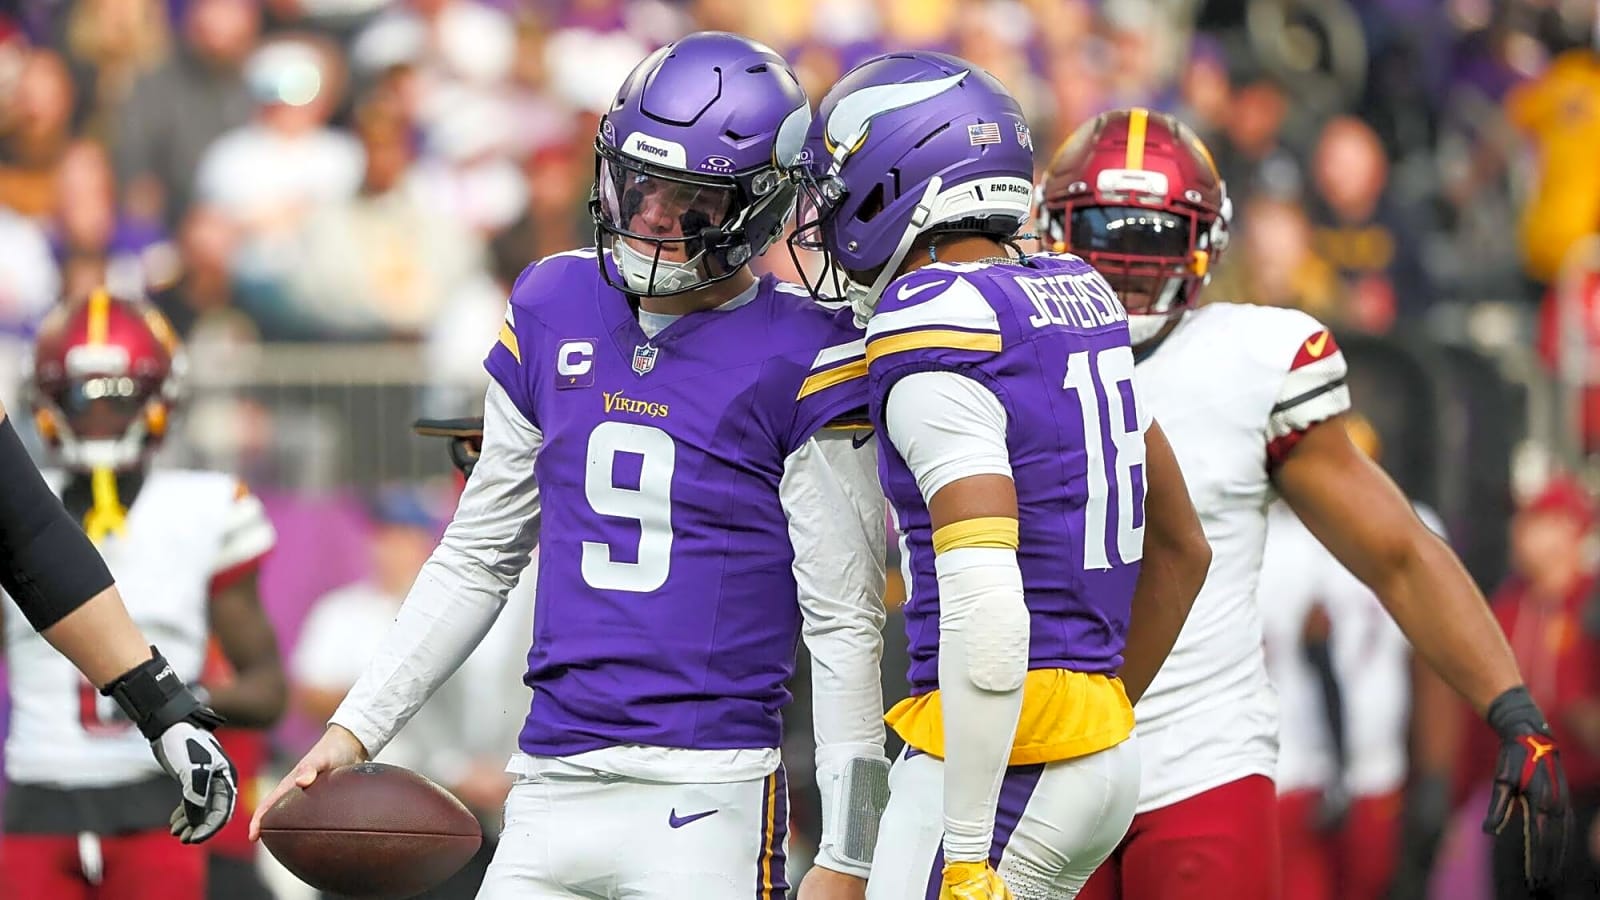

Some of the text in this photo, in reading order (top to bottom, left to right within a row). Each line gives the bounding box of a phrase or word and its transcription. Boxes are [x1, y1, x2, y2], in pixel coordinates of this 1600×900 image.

[990, 184, 1007, 192] END
[557, 341, 594, 376] C
[635, 356, 653, 371] NFL
[1063, 345, 1147, 571] 18
[581, 421, 676, 592] 9
